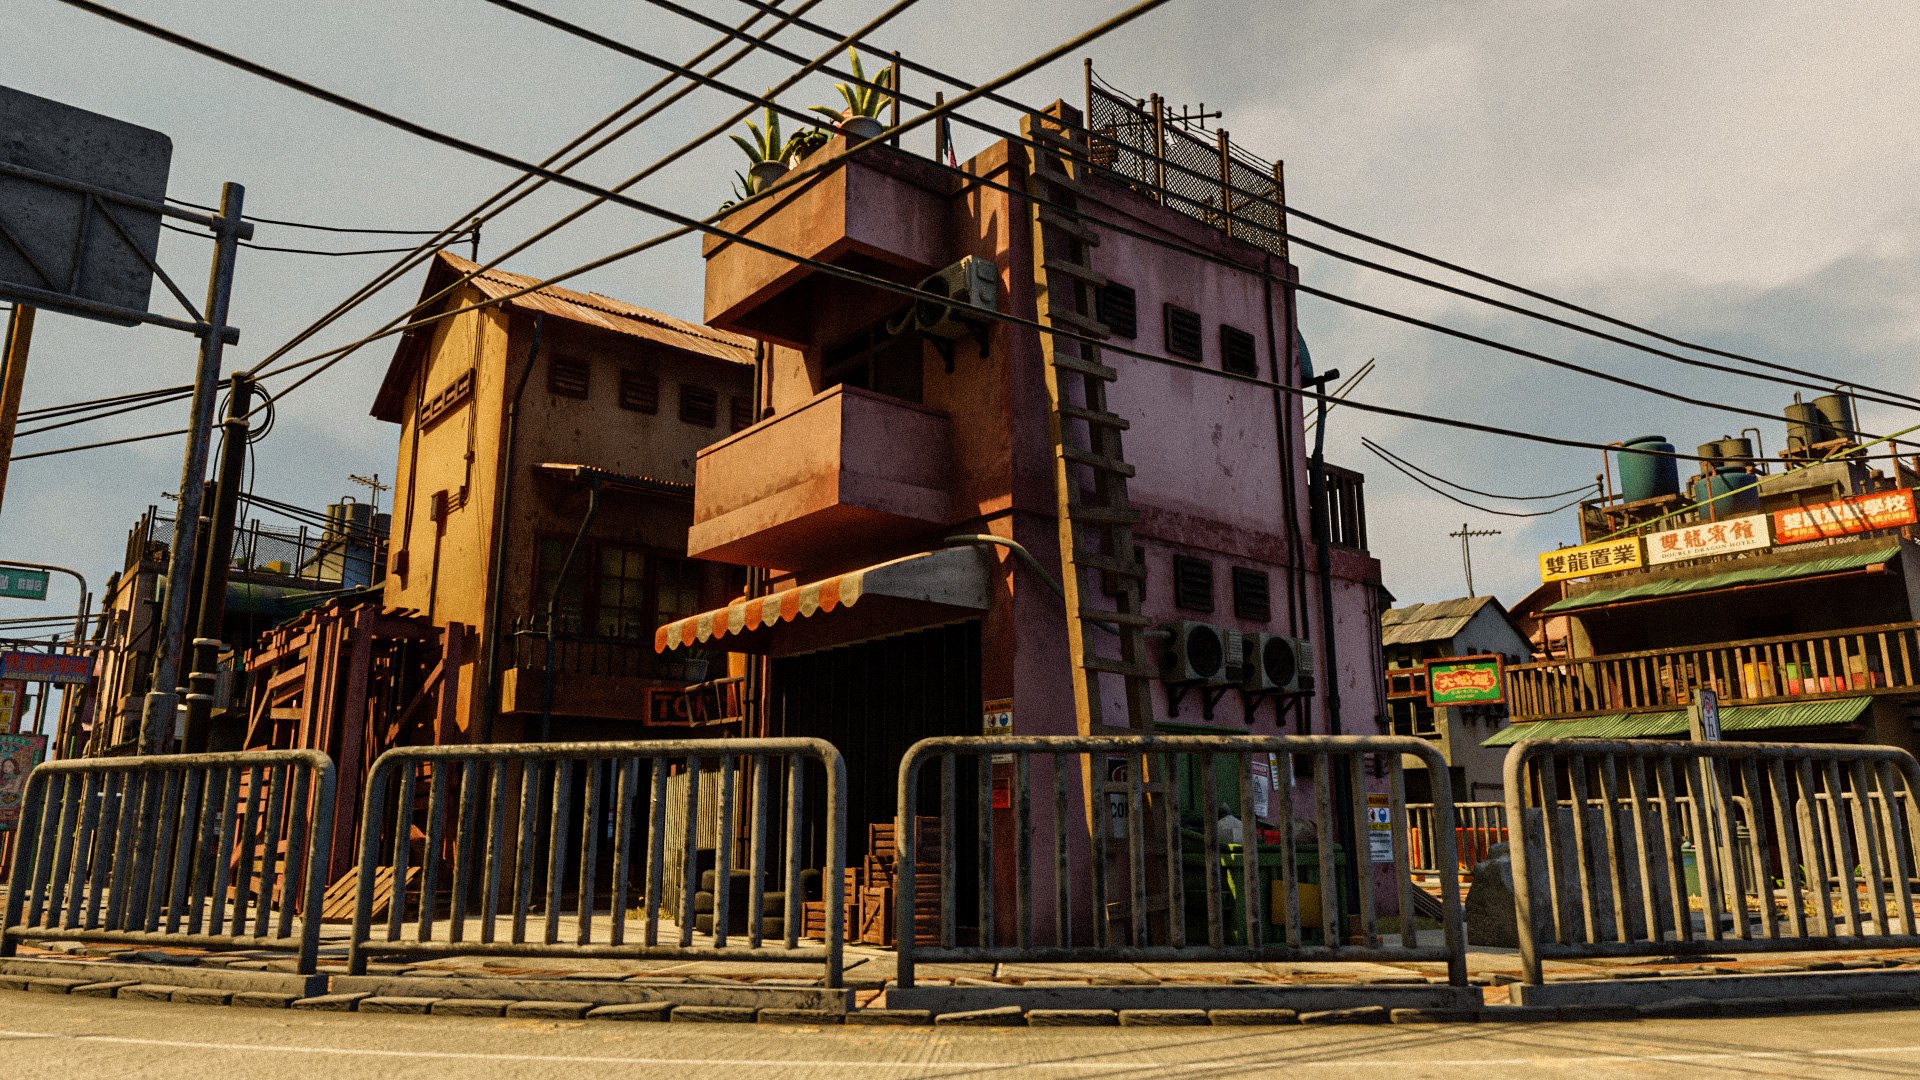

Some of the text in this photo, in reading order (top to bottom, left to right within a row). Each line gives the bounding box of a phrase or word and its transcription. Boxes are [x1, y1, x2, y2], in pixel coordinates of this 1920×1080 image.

[1659, 520, 1755, 552] 雙龍賓館
[1661, 549, 1692, 559] DOUBLE
[1694, 544, 1727, 554] DRAGON
[1729, 539, 1757, 548] HOTEL
[1545, 543, 1636, 576] 雙龍置業
[3, 671, 87, 683] AMUSEMENT ARCADE
